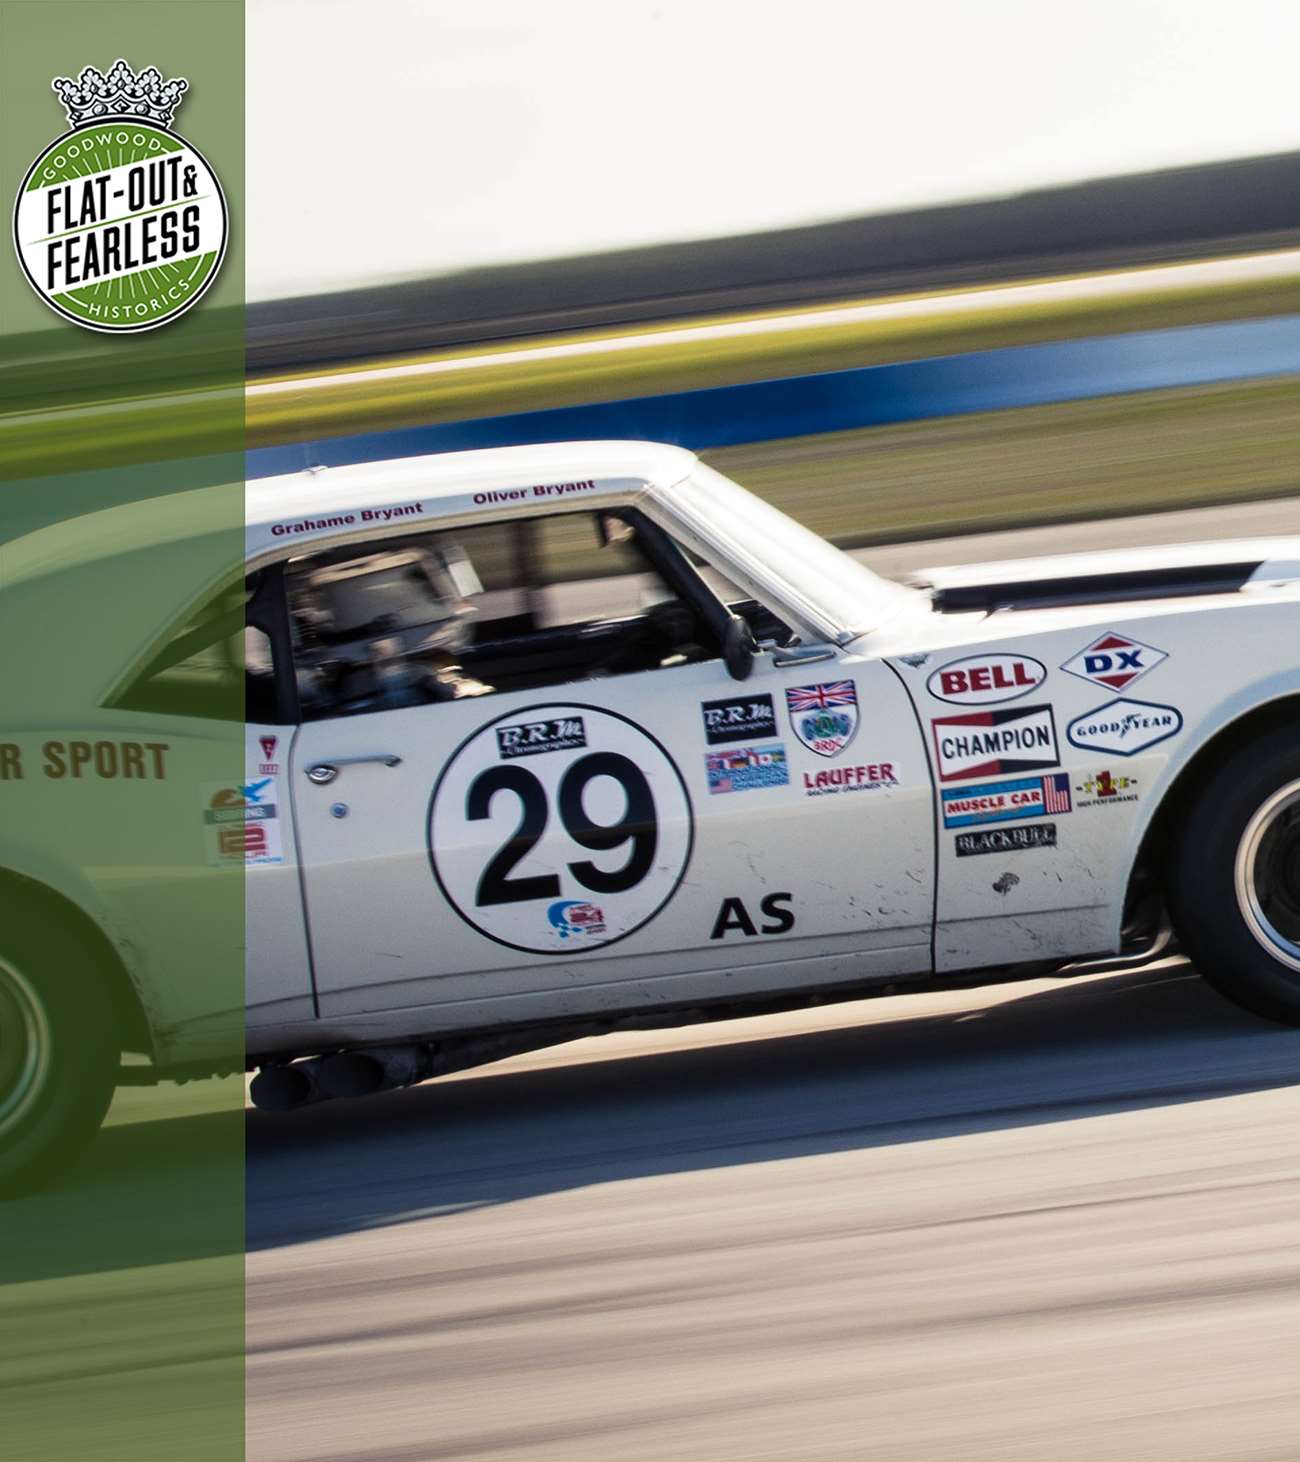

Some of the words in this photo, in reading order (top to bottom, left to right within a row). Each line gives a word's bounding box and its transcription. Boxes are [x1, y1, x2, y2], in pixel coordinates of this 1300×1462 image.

[472, 487, 528, 505] Oliver
[532, 479, 596, 497] Bryant
[271, 513, 355, 537] Grahame
[361, 501, 424, 522] Bryant
[939, 662, 1036, 695] BELL
[1084, 649, 1145, 674] DX
[940, 725, 1051, 760] CHAMPION
[42, 740, 170, 780] SPORT
[803, 763, 898, 789] LAUFFER
[946, 795, 1006, 814] MUSCLE
[1010, 791, 1042, 805] CAR
[465, 751, 658, 908] 29
[709, 891, 796, 940] AS
